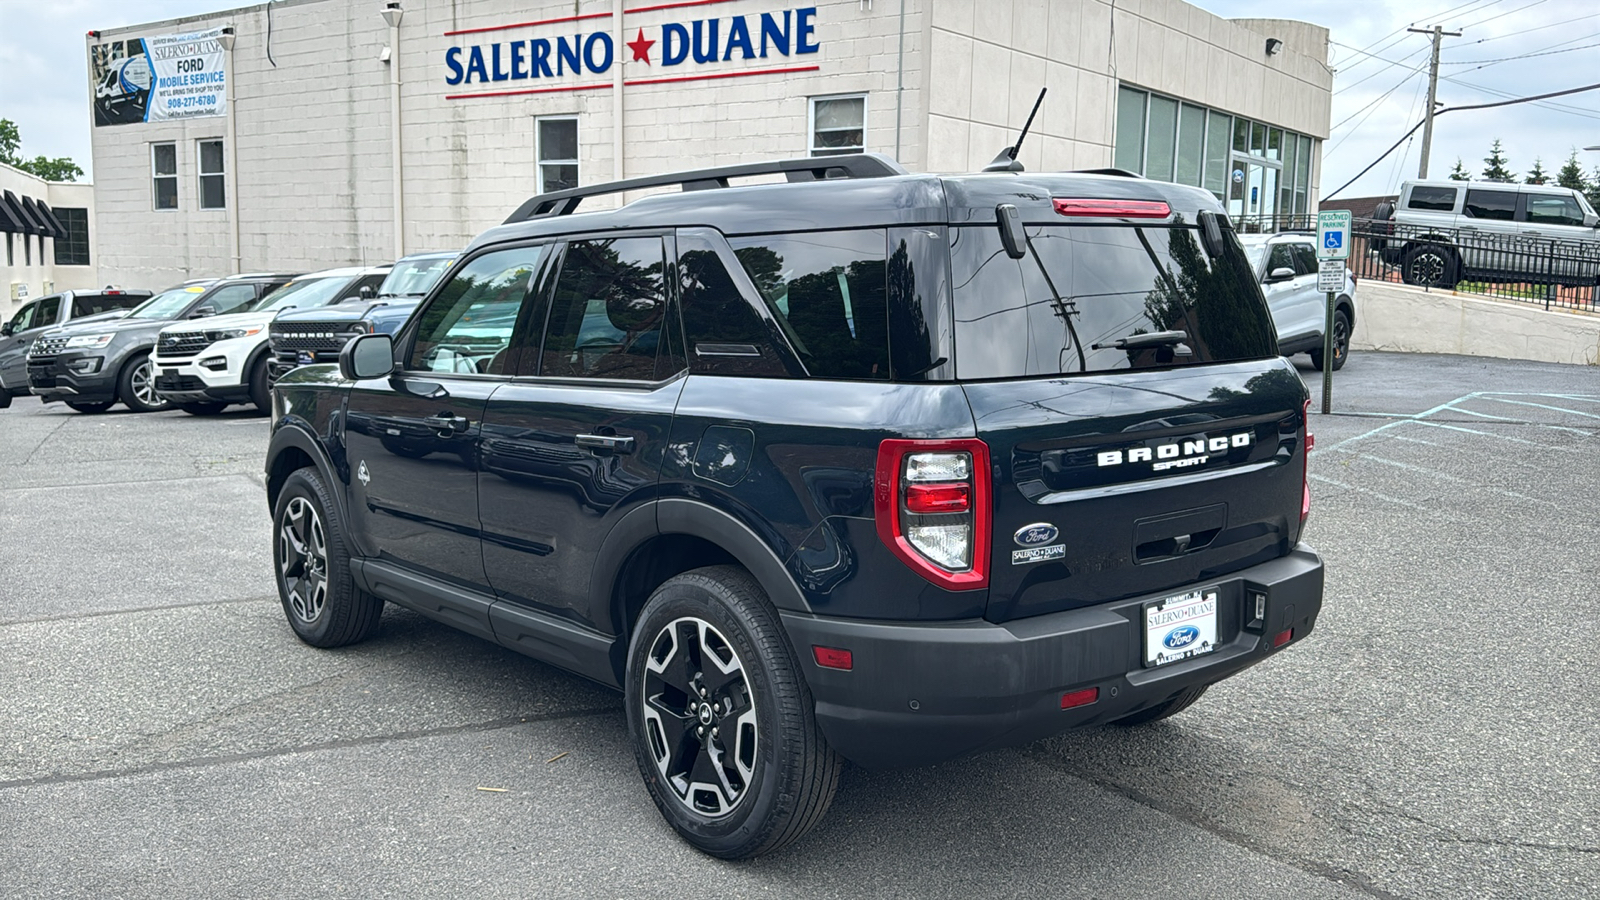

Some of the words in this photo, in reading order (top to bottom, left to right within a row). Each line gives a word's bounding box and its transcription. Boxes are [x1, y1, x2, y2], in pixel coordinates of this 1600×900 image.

[155, 43, 189, 58] SALERNO
[193, 40, 222, 54] DUANE
[445, 31, 614, 86] SALERNO
[661, 7, 821, 67] DUANE
[177, 58, 204, 73] FORD
[159, 75, 189, 88] MOBILE
[190, 71, 224, 85] SERVICE
[167, 94, 216, 109] 908-277-6780
[1097, 432, 1250, 467] BRONCO
[1152, 455, 1209, 471] SPORT
[1025, 527, 1051, 543] Ford
[1014, 549, 1040, 560] SALERNO
[1044, 546, 1064, 555] DUANE
[1148, 609, 1184, 627] SALERNO
[1187, 601, 1214, 617] DUANE
[1170, 628, 1194, 647] Ford
[1156, 652, 1185, 666] SALERNO
[1192, 645, 1214, 656] DUANE
